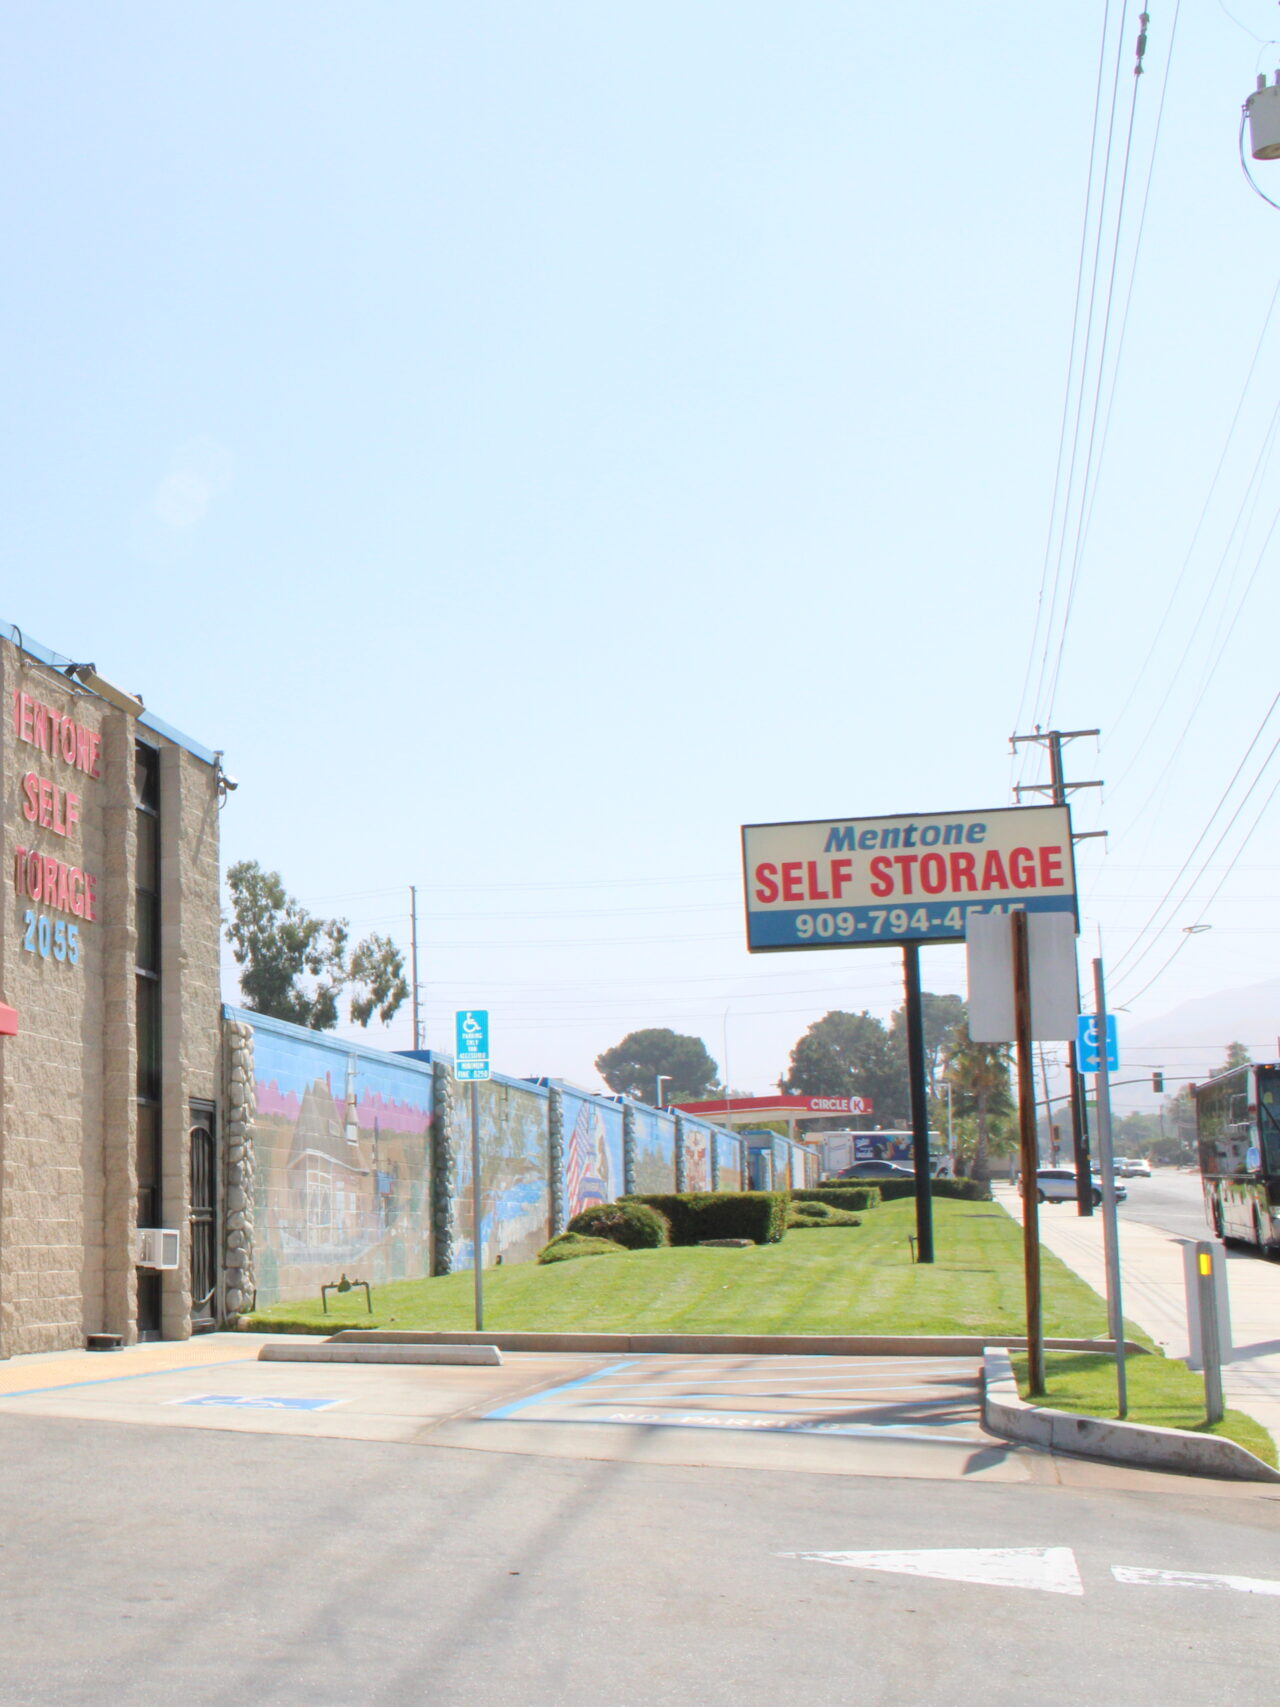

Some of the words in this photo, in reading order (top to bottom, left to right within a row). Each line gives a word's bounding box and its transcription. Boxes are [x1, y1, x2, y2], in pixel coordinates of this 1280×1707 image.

[23, 771, 81, 837] SELF
[823, 822, 988, 853] Mentone
[15, 844, 97, 922] TORAGE
[755, 858, 854, 904] SELF
[869, 845, 1065, 898] STORAGE
[23, 909, 80, 965] 2055
[795, 902, 1026, 939] 909-794-4
[811, 1098, 848, 1110] CIRCLE
